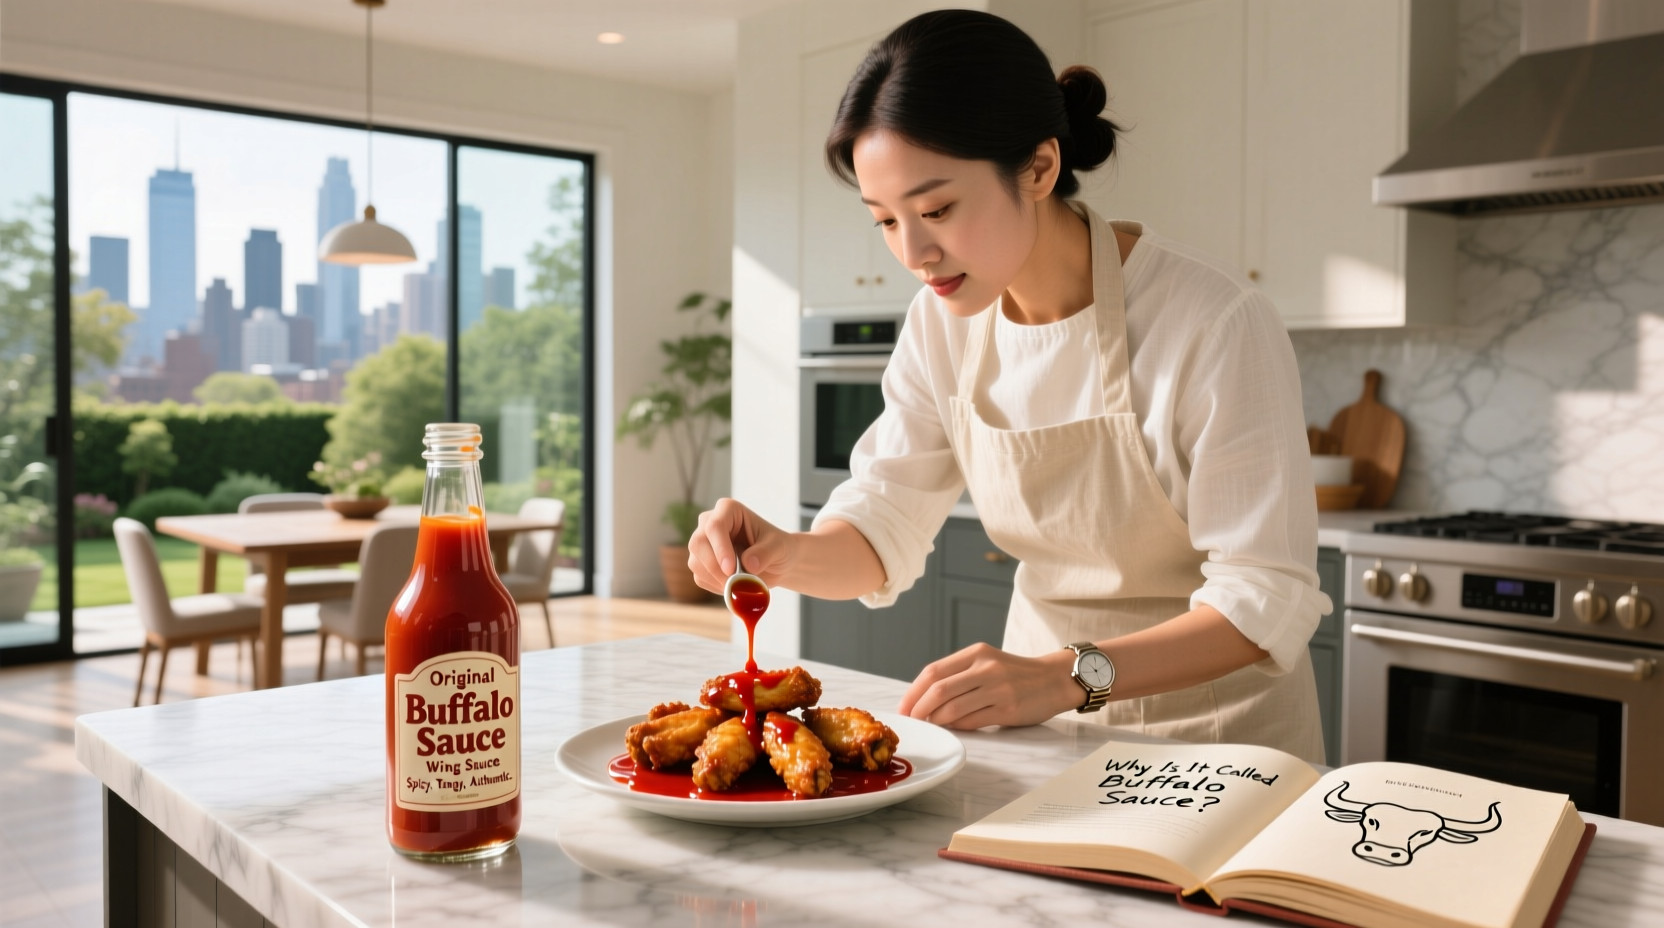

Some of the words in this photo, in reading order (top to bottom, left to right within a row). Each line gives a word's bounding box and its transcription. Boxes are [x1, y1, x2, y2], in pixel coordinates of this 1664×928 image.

[430, 667, 495, 690] Original
[405, 689, 514, 725] Buffalo
[416, 726, 506, 757] Sauce
[426, 760, 461, 776] Wing
[1105, 758, 1152, 777] Why
[1159, 761, 1180, 773] Is
[1186, 761, 1210, 773] It
[1216, 764, 1280, 787] Called
[1098, 774, 1226, 792] Buffalo
[1098, 790, 1221, 813] Sauce?
